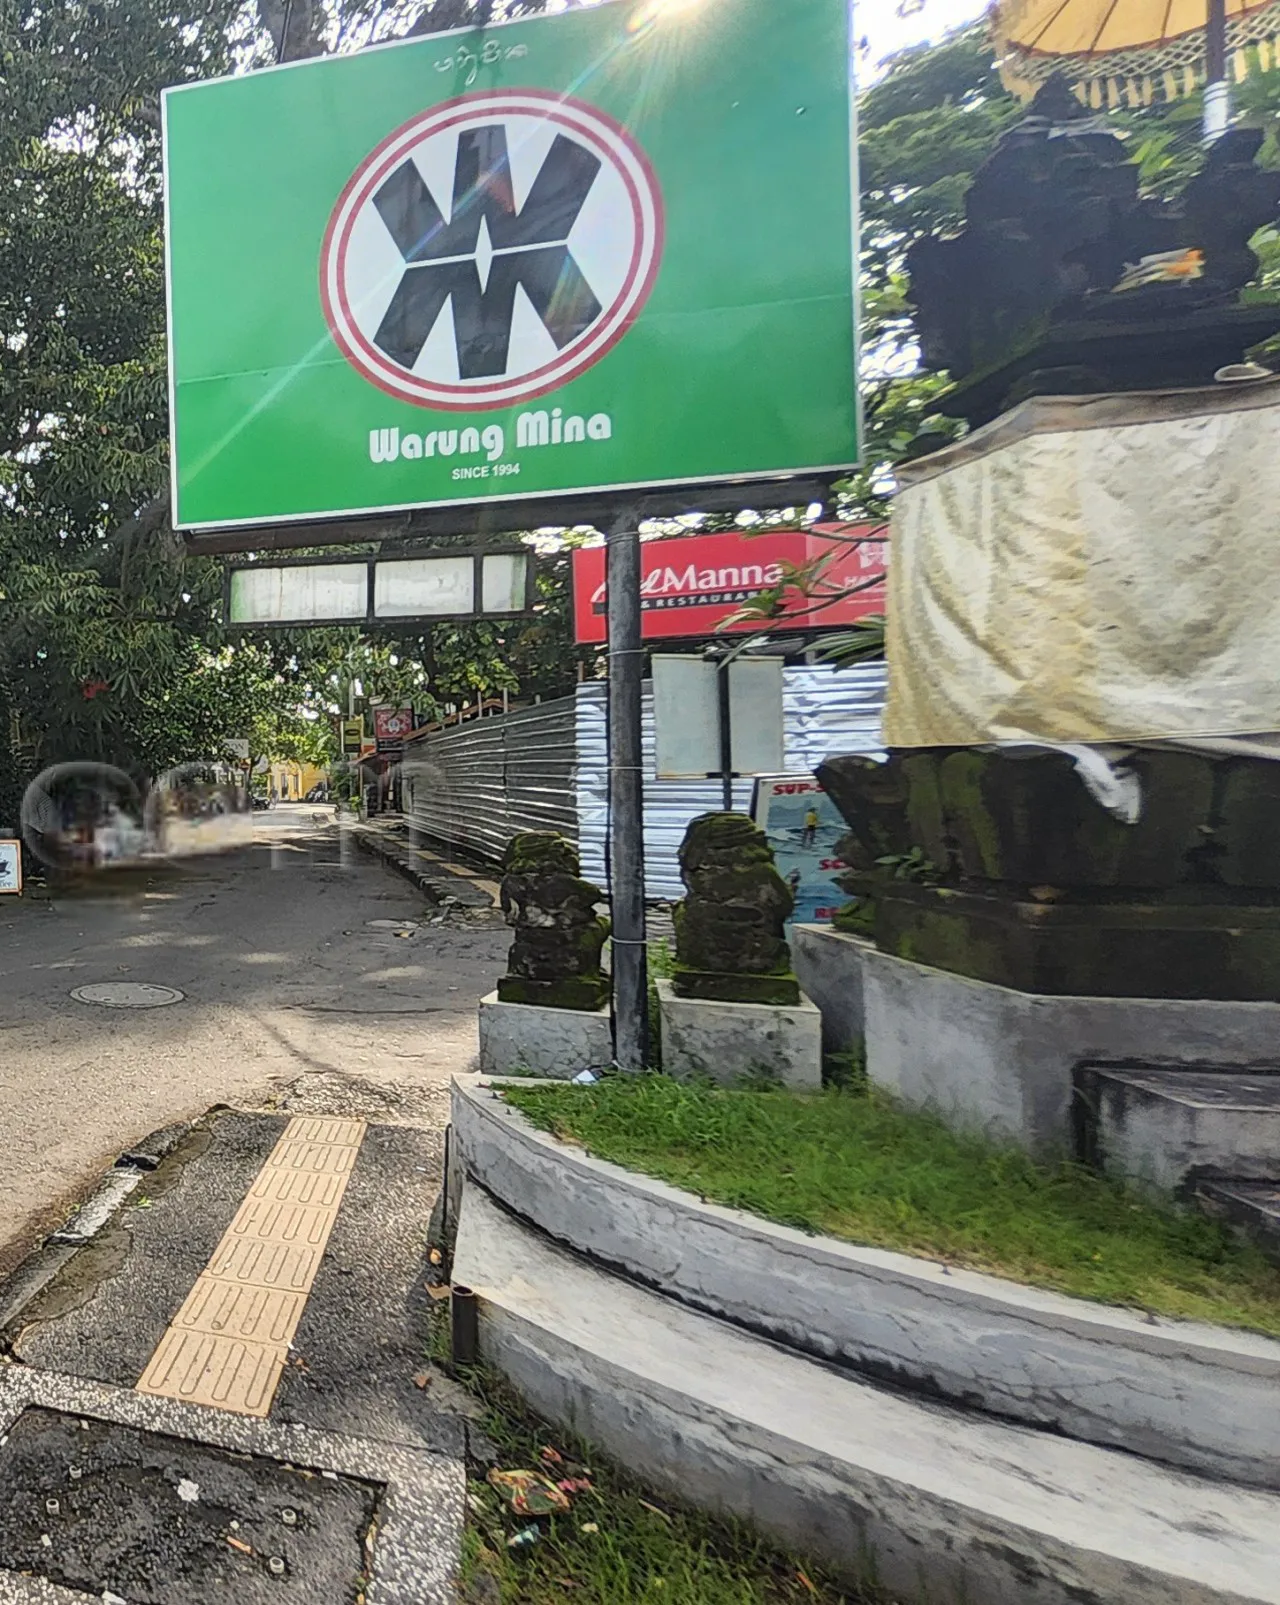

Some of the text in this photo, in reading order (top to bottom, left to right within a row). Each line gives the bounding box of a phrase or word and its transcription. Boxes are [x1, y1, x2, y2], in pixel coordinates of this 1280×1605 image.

[369, 407, 612, 464] Warung Mina
[452, 463, 521, 480] SINCE 1994
